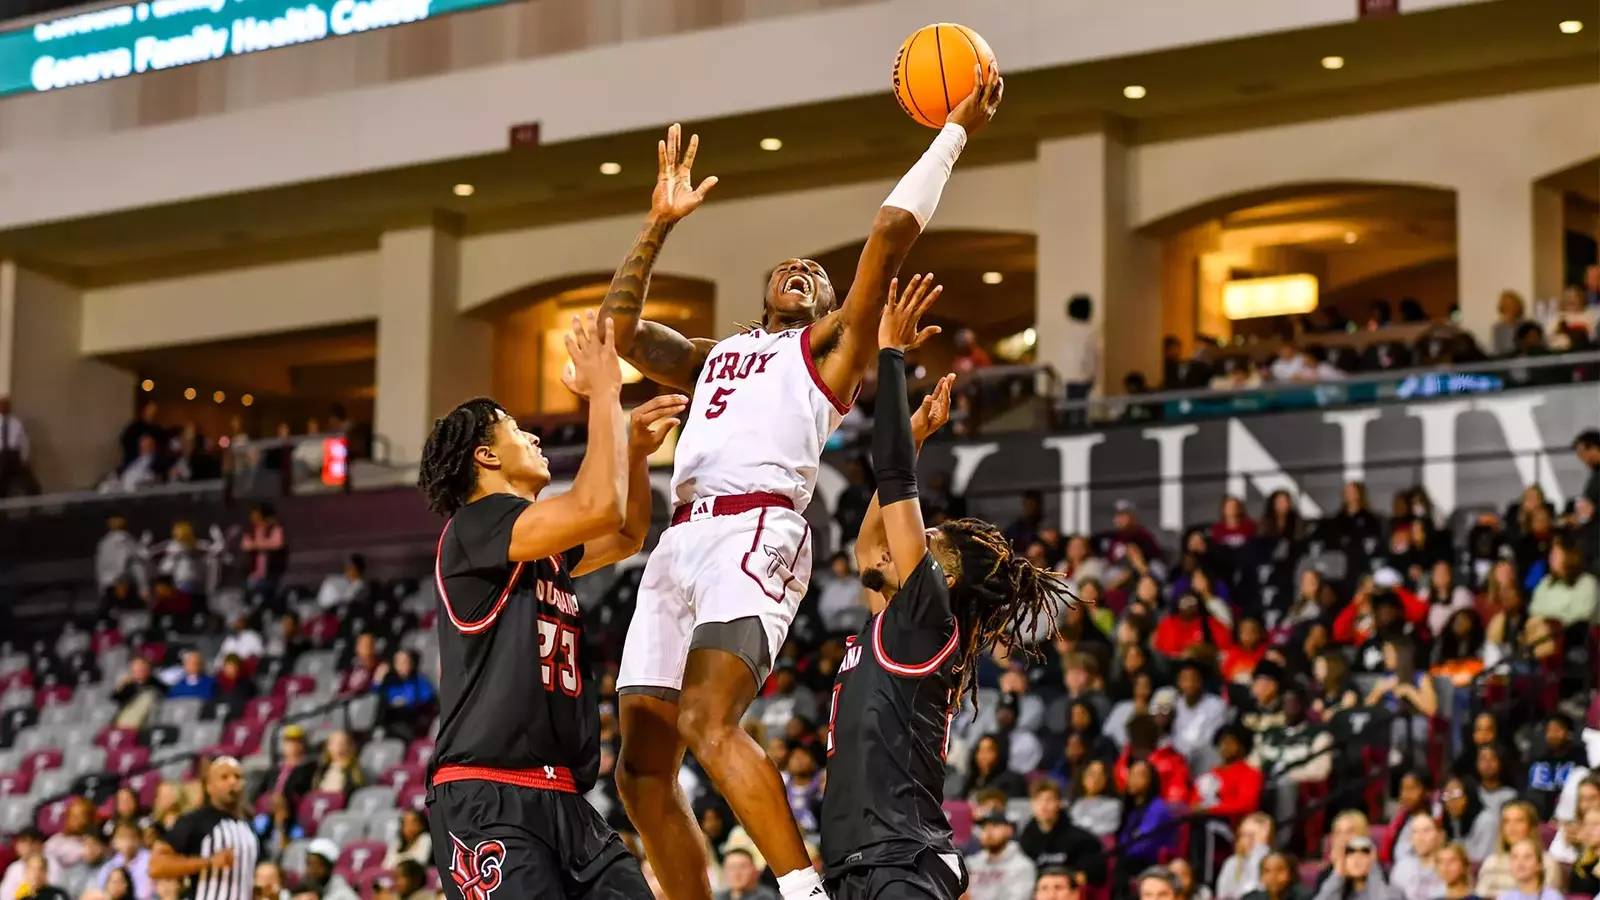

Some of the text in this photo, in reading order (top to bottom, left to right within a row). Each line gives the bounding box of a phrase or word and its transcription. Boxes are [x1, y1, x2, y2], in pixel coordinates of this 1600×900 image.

[705, 351, 779, 383] TROY
[705, 387, 736, 419] 5
[537, 614, 581, 696] 23
